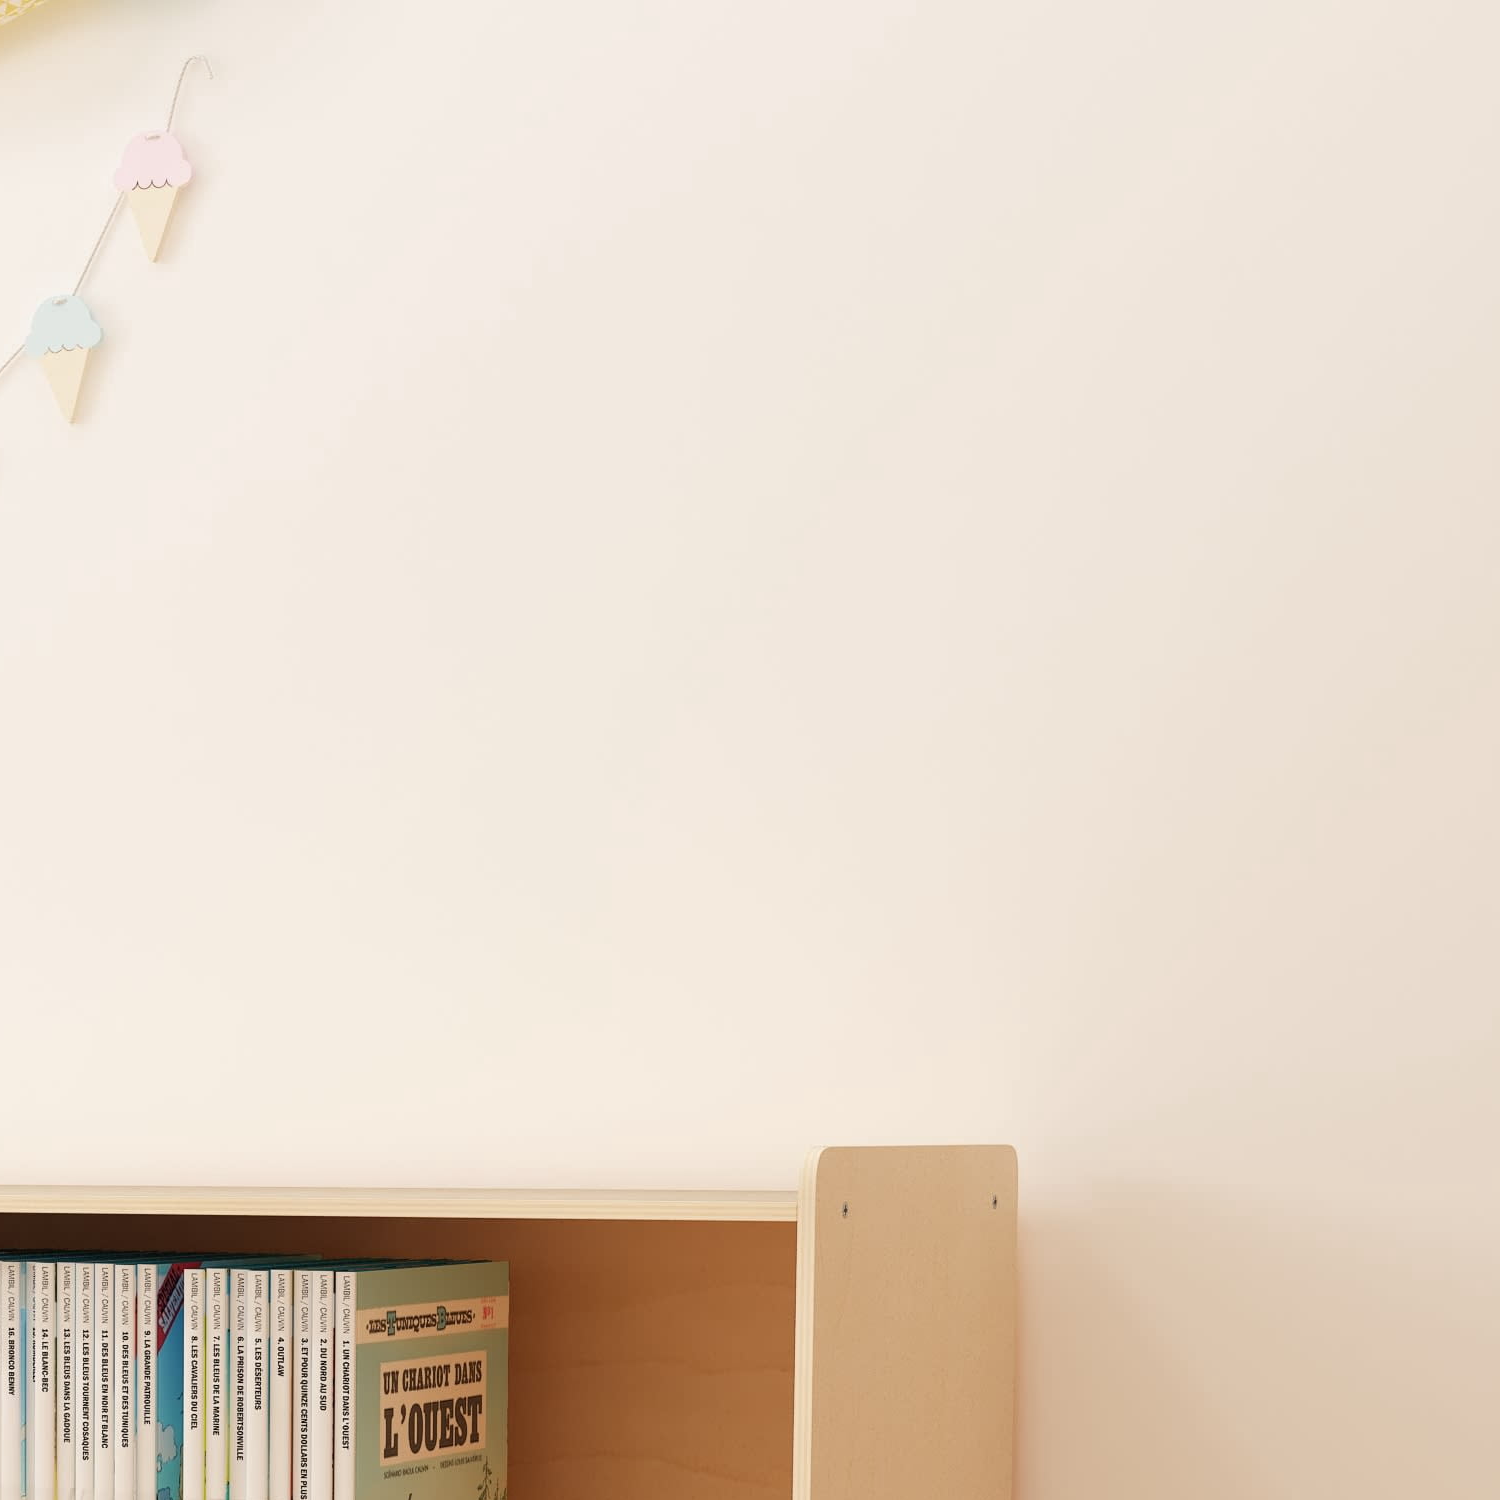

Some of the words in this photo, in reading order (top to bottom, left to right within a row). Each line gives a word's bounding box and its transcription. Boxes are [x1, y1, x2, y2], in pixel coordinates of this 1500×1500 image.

[82, 1266, 90, 1292] LAMBIL
[343, 1275, 351, 1302] LAMBIL
[82, 1298, 90, 1324] CAUVIN
[342, 1308, 351, 1334] CAUVIN
[368, 1319, 387, 1334] LES
[386, 1310, 437, 1336] TUNIQUES
[436, 1306, 473, 1331] BLEUES
[41, 1328, 49, 1340] 14.
[41, 1341, 49, 1350] LE
[82, 1329, 90, 1341] 12.
[144, 1329, 151, 1338] 9.
[144, 1339, 151, 1349] LA
[237, 1335, 245, 1344] 6.
[301, 1337, 309, 1346] 3.
[82, 1342, 90, 1356] LES
[237, 1345, 244, 1355] LA
[301, 1346, 309, 1356] ET
[342, 1348, 350, 1360] UN
[41, 1351, 49, 1393] BLANC-BEC
[82, 1356, 90, 1381] BLEUS
[342, 1361, 350, 1394] CHARIOT
[383, 1370, 400, 1395] UN
[402, 1364, 451, 1393] CHARIOT
[454, 1360, 482, 1386] DANS
[143, 1381, 151, 1425] PATROUILLE
[237, 1385, 244, 1396] DE
[300, 1379, 308, 1408] QUINZE
[342, 1395, 350, 1417] DANS
[236, 1396, 244, 1461] ROBERTSONVILLE
[300, 1408, 308, 1433] CENTS
[384, 1395, 483, 1459] L'OUEST
[81, 1421, 89, 1461] COSAQUES
[342, 1417, 350, 1450] L'OUEST
[300, 1433, 308, 1468] DOLLARS
[300, 1468, 308, 1479] EN
[300, 1480, 308, 1500] PLUS
